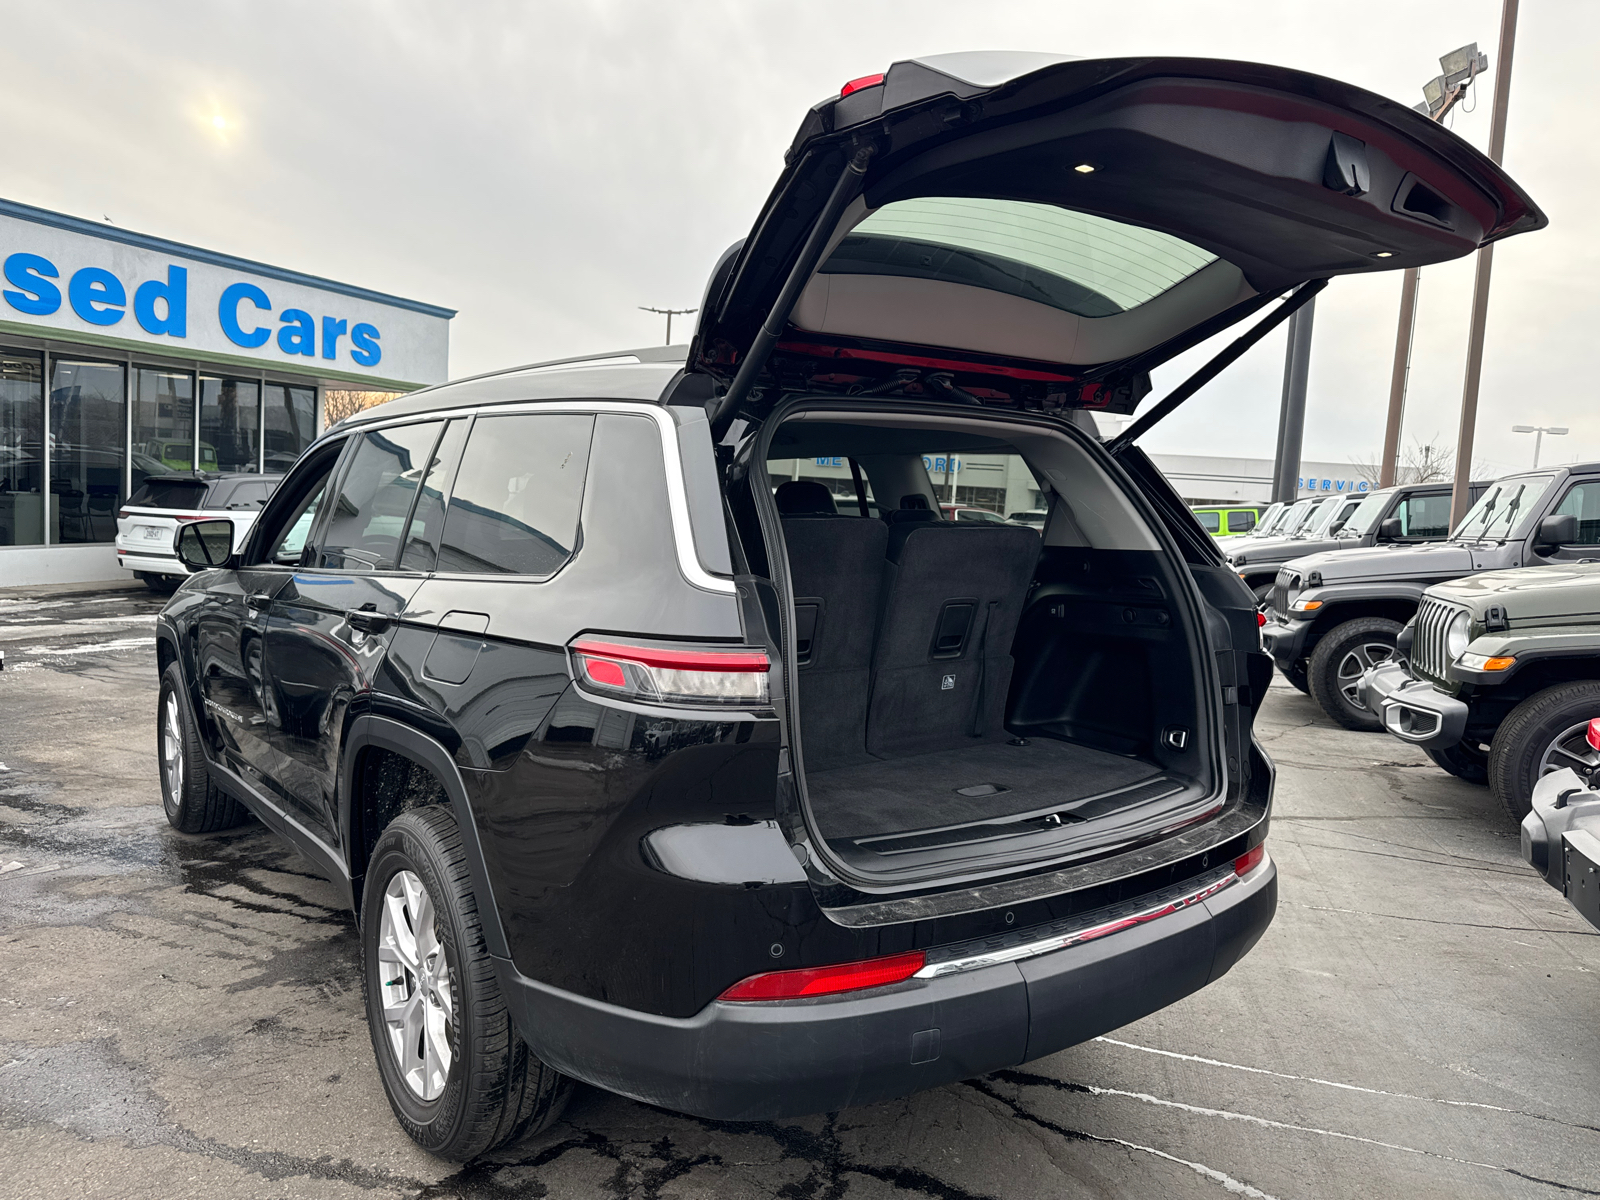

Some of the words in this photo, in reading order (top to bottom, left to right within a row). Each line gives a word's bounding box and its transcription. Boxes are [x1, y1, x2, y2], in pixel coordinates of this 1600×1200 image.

[3, 252, 188, 339] sed
[218, 282, 382, 367] Cars
[448, 966, 461, 1064] KUMHO
